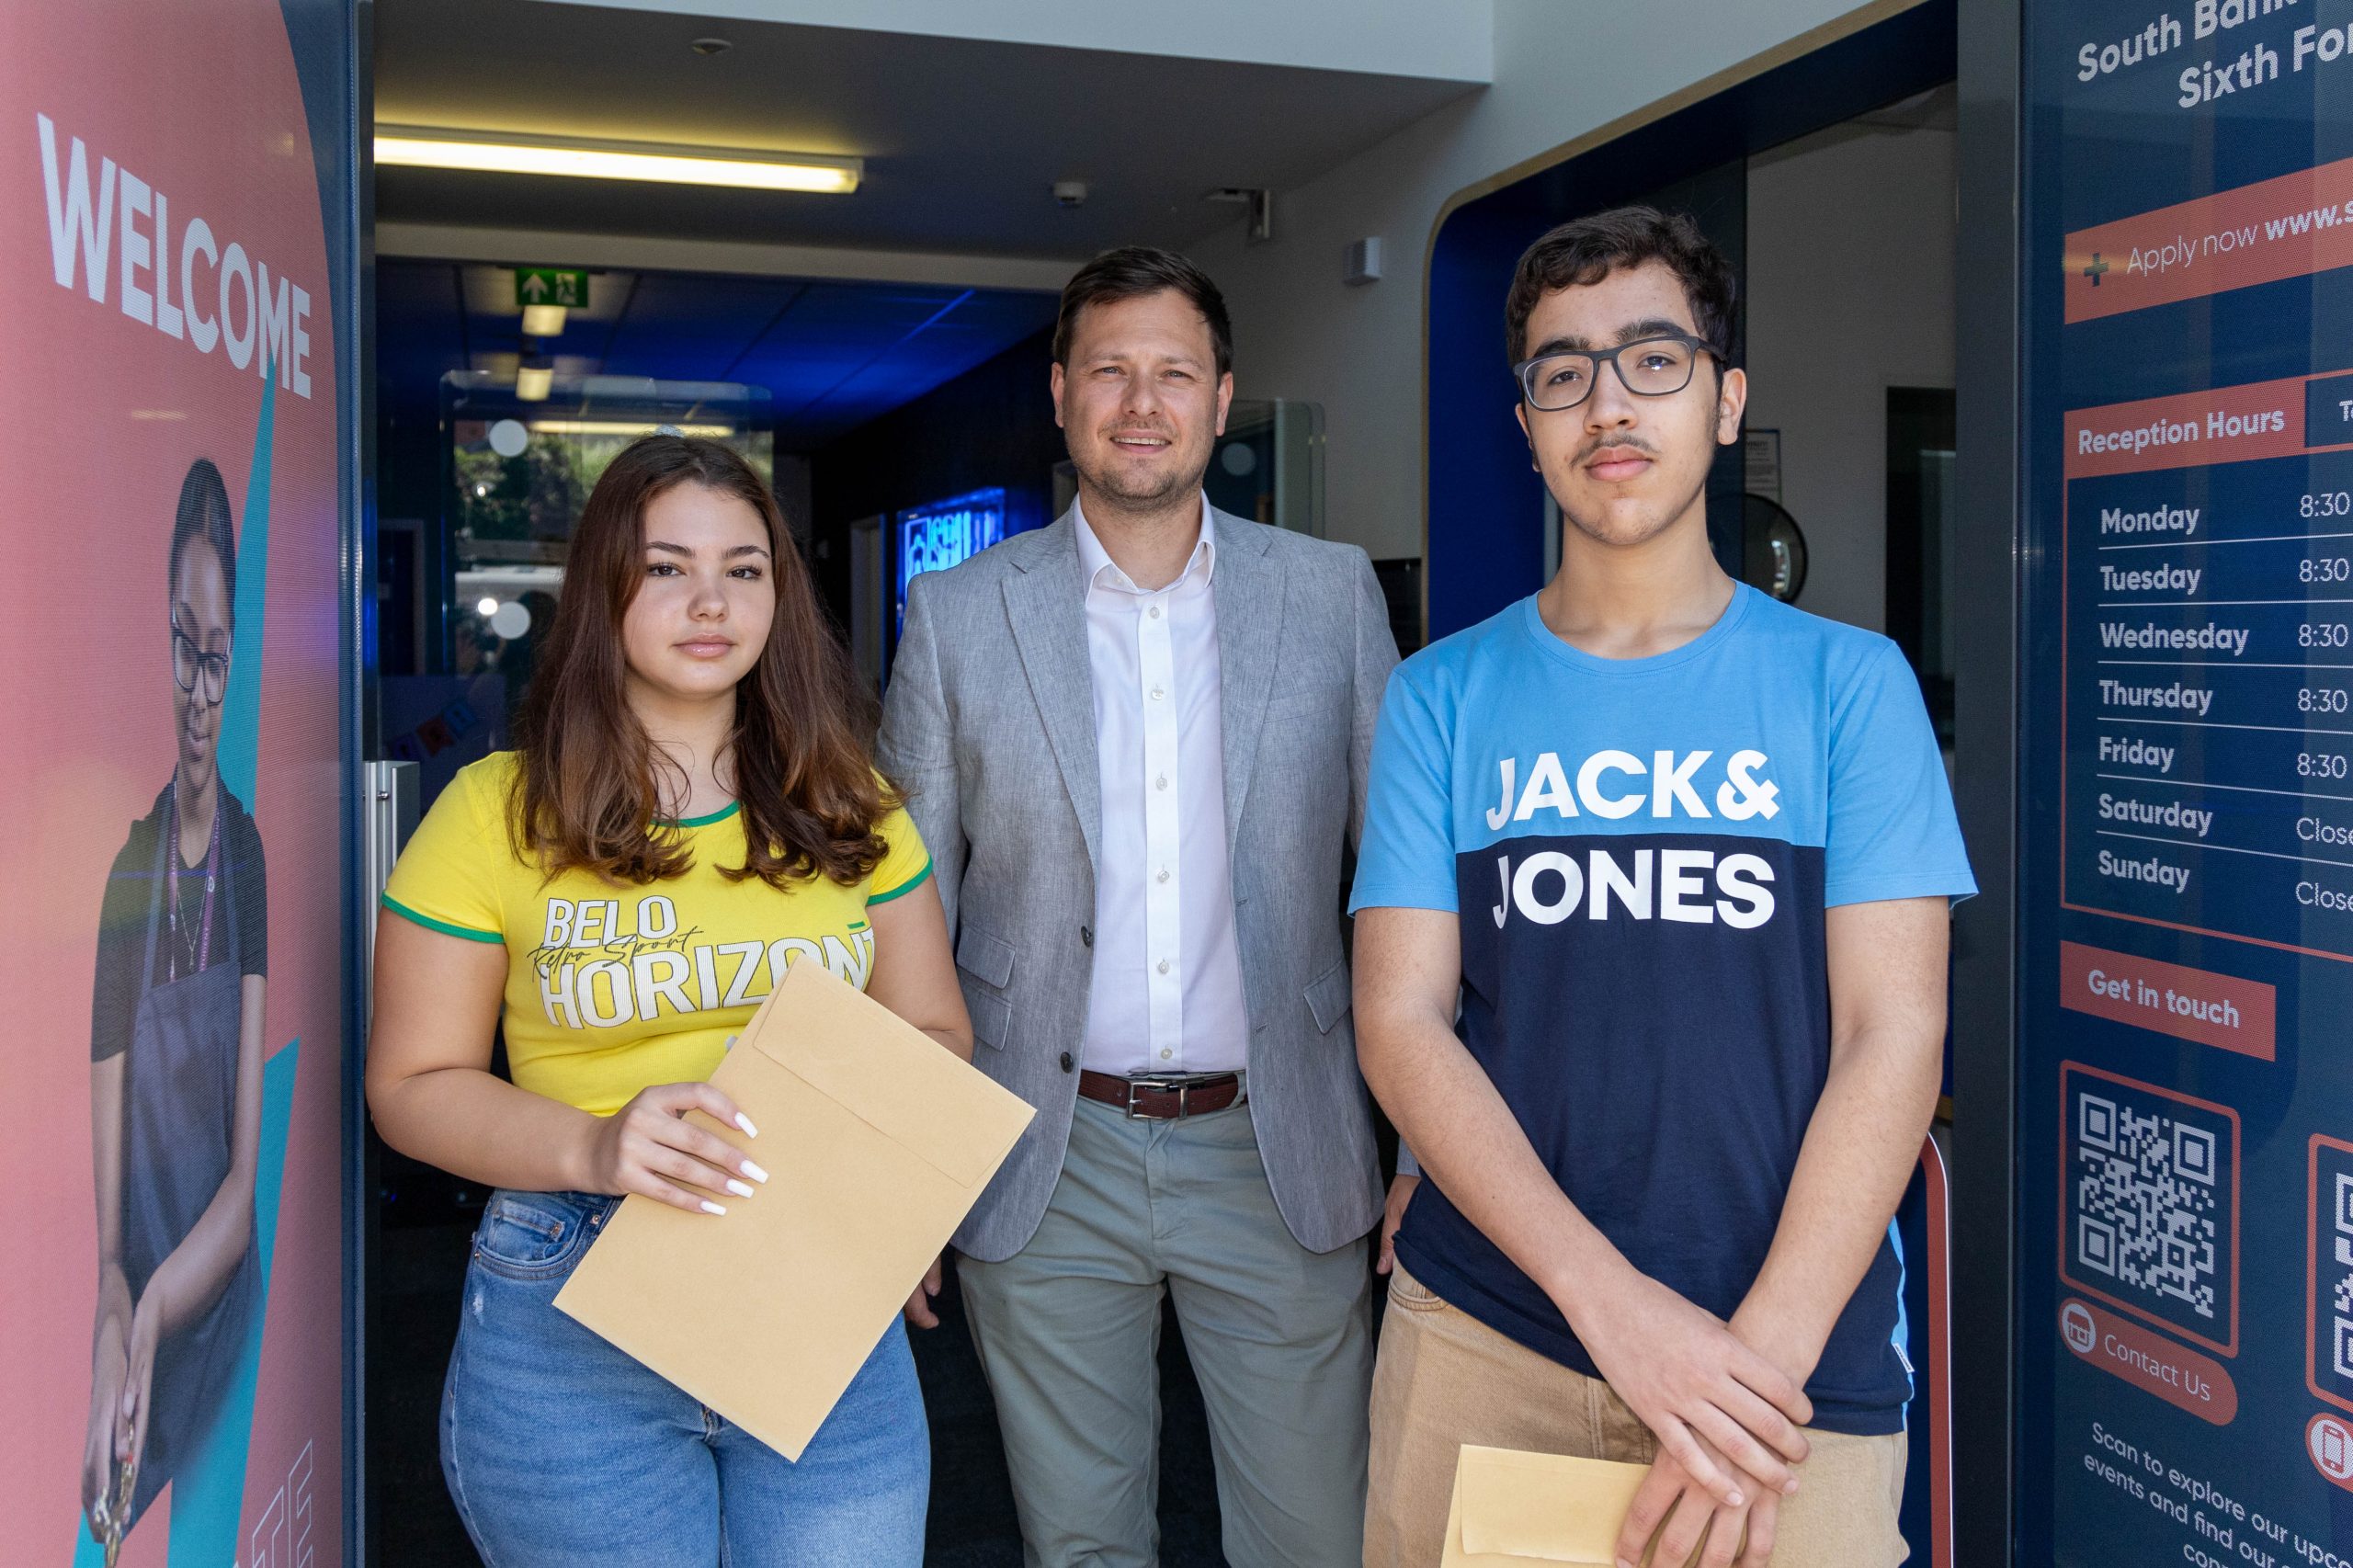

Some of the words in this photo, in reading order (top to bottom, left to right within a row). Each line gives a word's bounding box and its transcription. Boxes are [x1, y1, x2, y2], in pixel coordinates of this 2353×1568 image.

[2077, 14, 2182, 82] South
[2195, 0, 2298, 40] Ban
[2178, 43, 2279, 108] Sixth
[38, 112, 312, 400] WELCOME
[2127, 235, 2198, 277] Apply
[2203, 224, 2258, 256] now
[2078, 419, 2200, 455] Reception
[2207, 410, 2285, 439] Hours
[2100, 505, 2200, 535] Monday
[2300, 492, 2350, 517] 8:30
[2099, 563, 2201, 596] Tuesday
[2299, 558, 2350, 583] 8:30
[2099, 622, 2250, 656] Wednesday
[2299, 623, 2349, 647] 8:30
[2098, 679, 2213, 716] Thursday
[2298, 688, 2348, 713] 8:30
[2099, 736, 2175, 773] Friday
[2297, 753, 2347, 778] 8:30
[2098, 793, 2213, 837] Saturday
[1493, 849, 1776, 929] JONES
[2097, 849, 2190, 894] Sunday
[543, 894, 678, 949] BELO
[602, 926, 704, 967] Sport
[2088, 970, 2131, 1001] Get
[2137, 980, 2159, 1009] in
[2165, 989, 2240, 1028] touch
[2105, 1335, 2178, 1387] Contact
[2185, 1370, 2211, 1401] Us
[2084, 1455, 2144, 1499] events
[2150, 1491, 2188, 1525] and
[2193, 1511, 2233, 1550] find
[2092, 1422, 2138, 1464] Scan
[2143, 1451, 2163, 1476] to
[2169, 1469, 2245, 1521] explore
[2252, 1513, 2288, 1543] our
